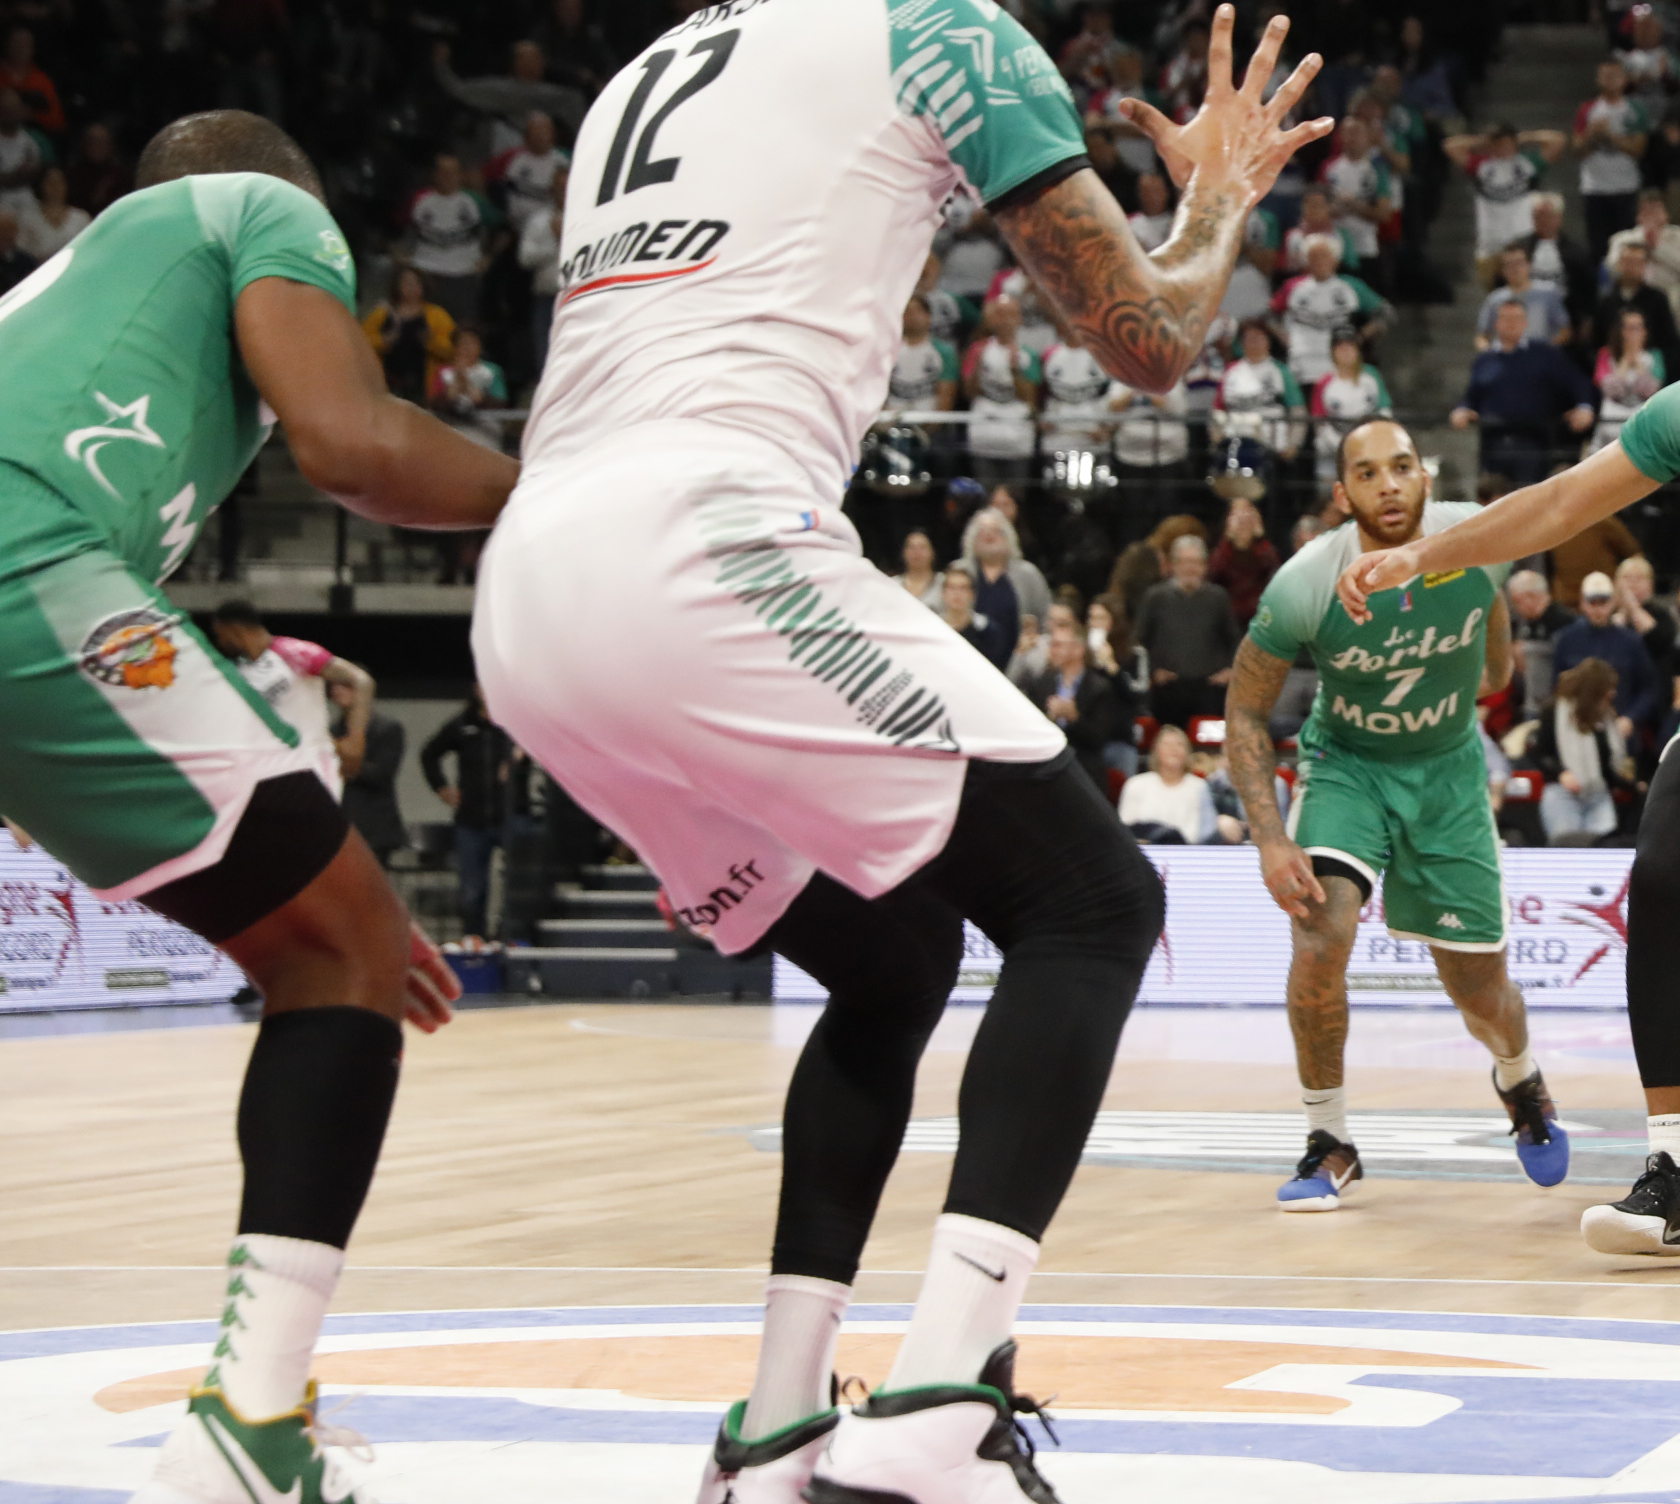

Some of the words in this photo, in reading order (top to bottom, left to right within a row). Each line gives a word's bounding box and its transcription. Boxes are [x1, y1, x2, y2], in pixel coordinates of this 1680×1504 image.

[595, 27, 741, 208] 12
[1330, 607, 1483, 673] Portel
[1383, 626, 1415, 648] Le
[1380, 666, 1426, 707] 7
